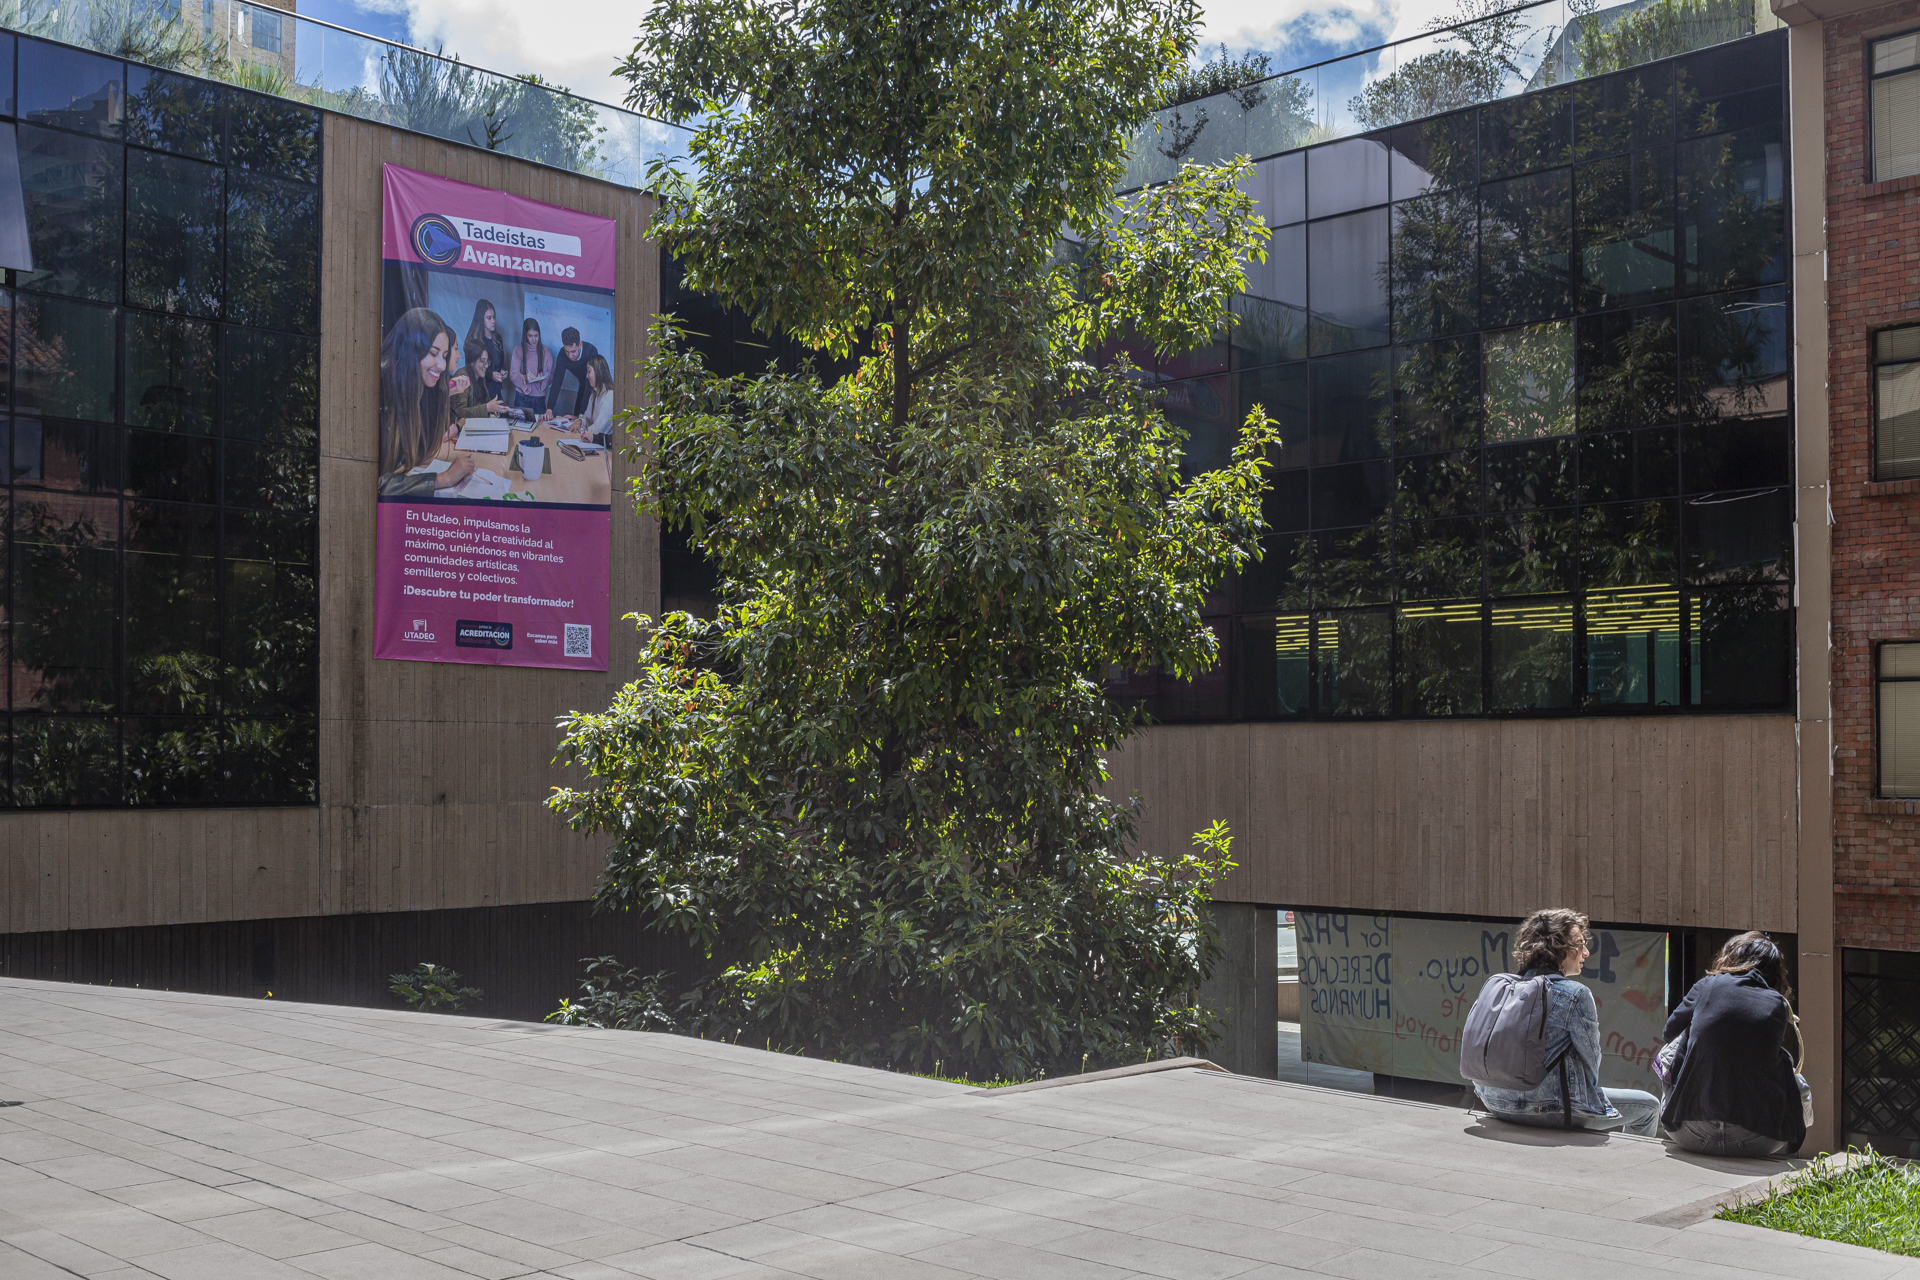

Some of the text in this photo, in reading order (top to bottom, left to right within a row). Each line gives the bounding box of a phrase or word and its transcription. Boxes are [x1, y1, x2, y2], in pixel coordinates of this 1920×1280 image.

[462, 221, 546, 250] Tadeístas
[462, 244, 576, 279] Avanzamos
[406, 510, 531, 533] En Utadeo, impulsamos la
[405, 523, 554, 550] investigación y la creatividad al
[404, 553, 474, 568] comunidades
[405, 539, 564, 564] máximo, uniéndonos en vibrantes
[403, 567, 518, 585] semilleros y colectivos.
[403, 585, 574, 608] ¡Descubre tu poder transformador!
[404, 631, 435, 640] UTADEO
